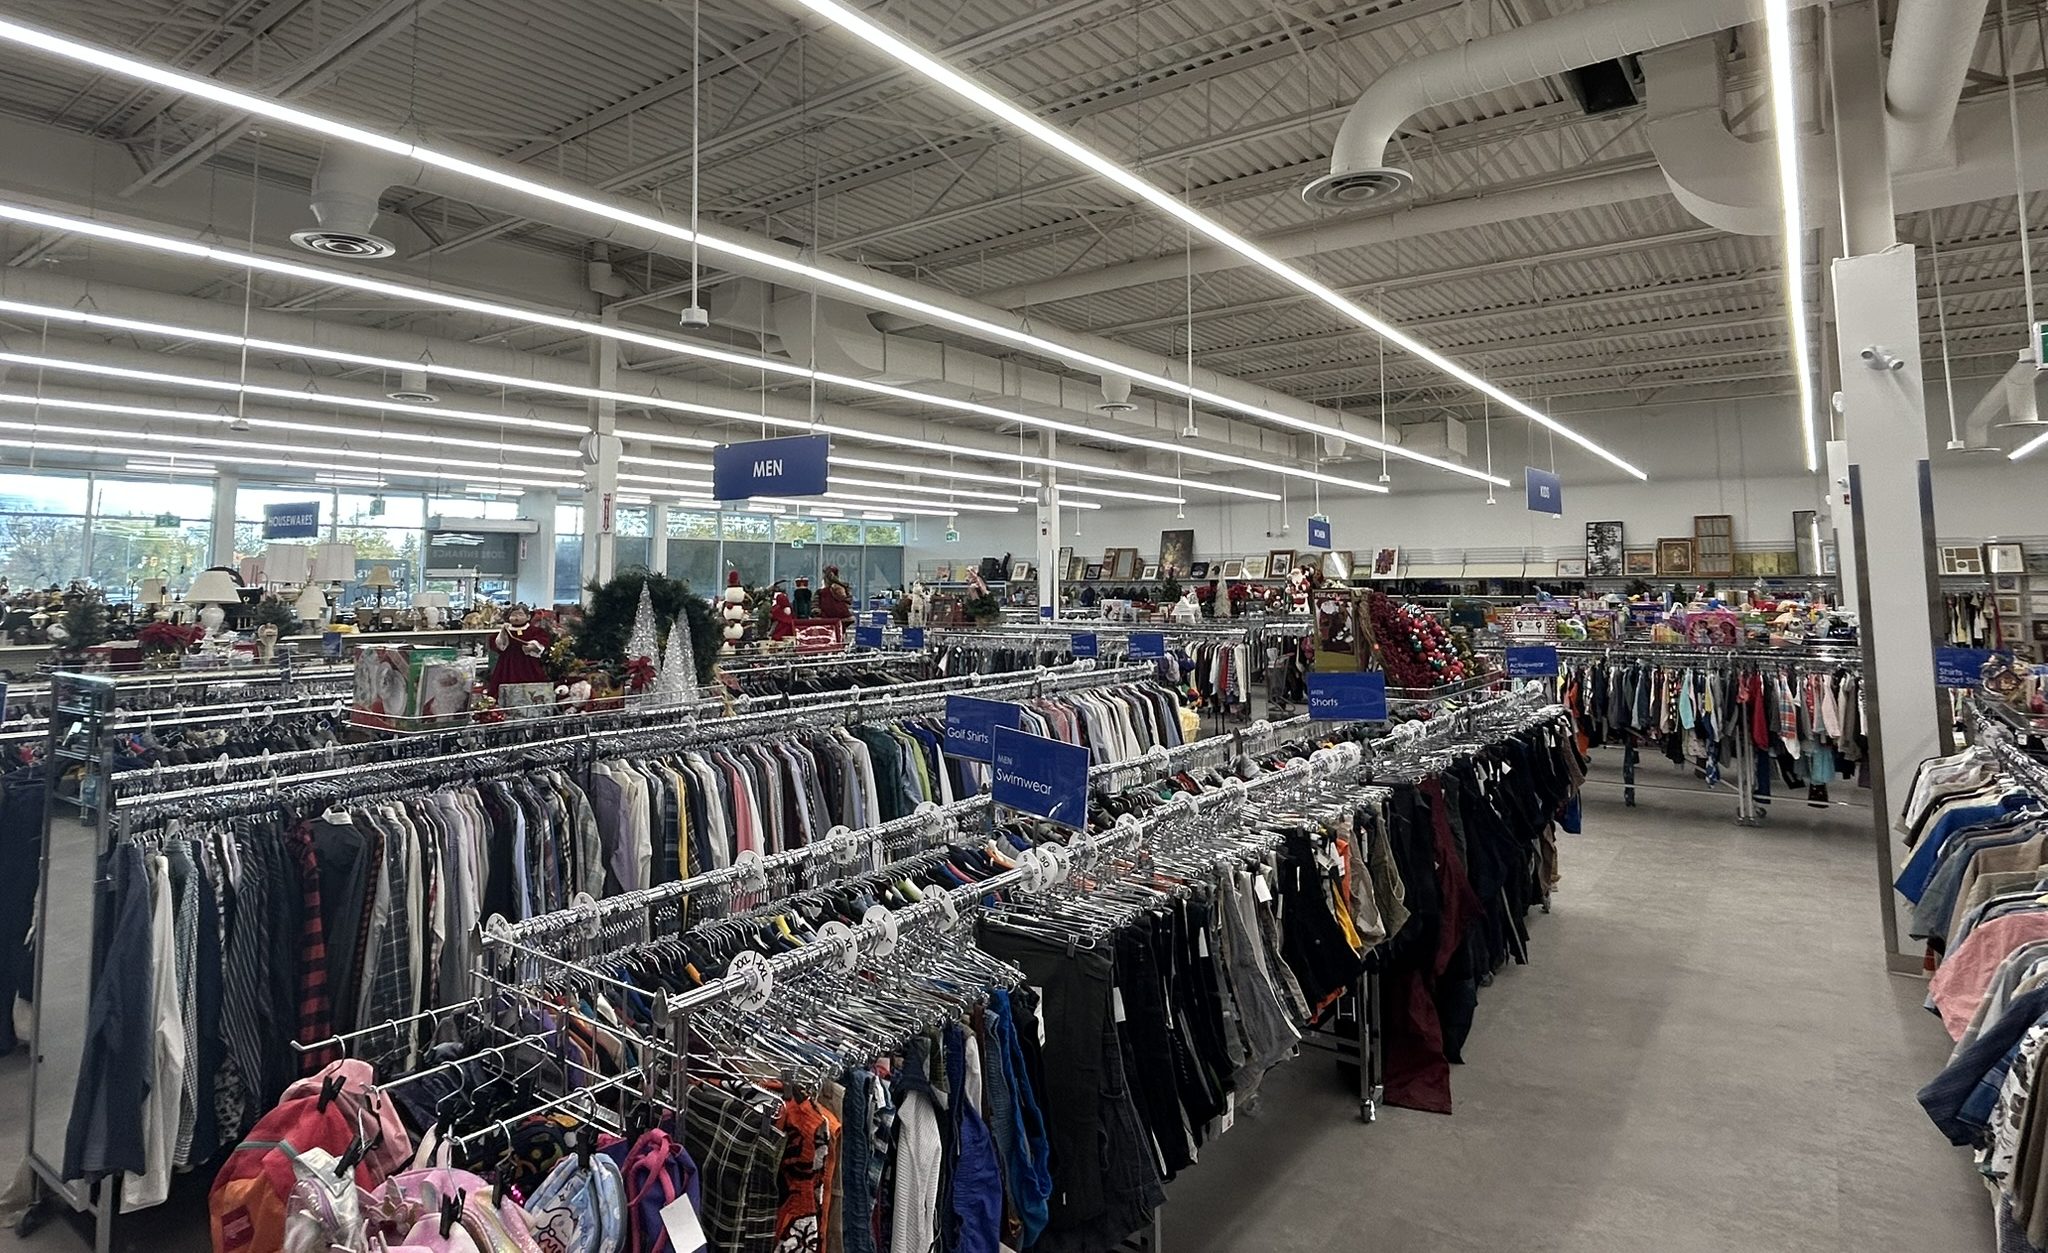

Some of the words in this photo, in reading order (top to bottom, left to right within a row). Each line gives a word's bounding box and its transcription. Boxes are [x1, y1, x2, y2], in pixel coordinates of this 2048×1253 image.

[752, 459, 783, 478] MEN
[267, 514, 313, 527] HOUSEWARES
[1938, 675, 1964, 683] Short
[1311, 697, 1338, 707] Shorts
[946, 726, 967, 740] Golf
[966, 730, 989, 744] Shirts
[997, 754, 1013, 766] MEN
[995, 767, 1053, 796] Swimwear
[1046, 845, 1057, 854] 42
[1039, 855, 1050, 868] 50
[825, 925, 837, 937] XL
[844, 938, 853, 952] XL
[733, 955, 751, 971] XXL
[756, 959, 768, 982] XXL
[747, 989, 766, 1005] XXL
